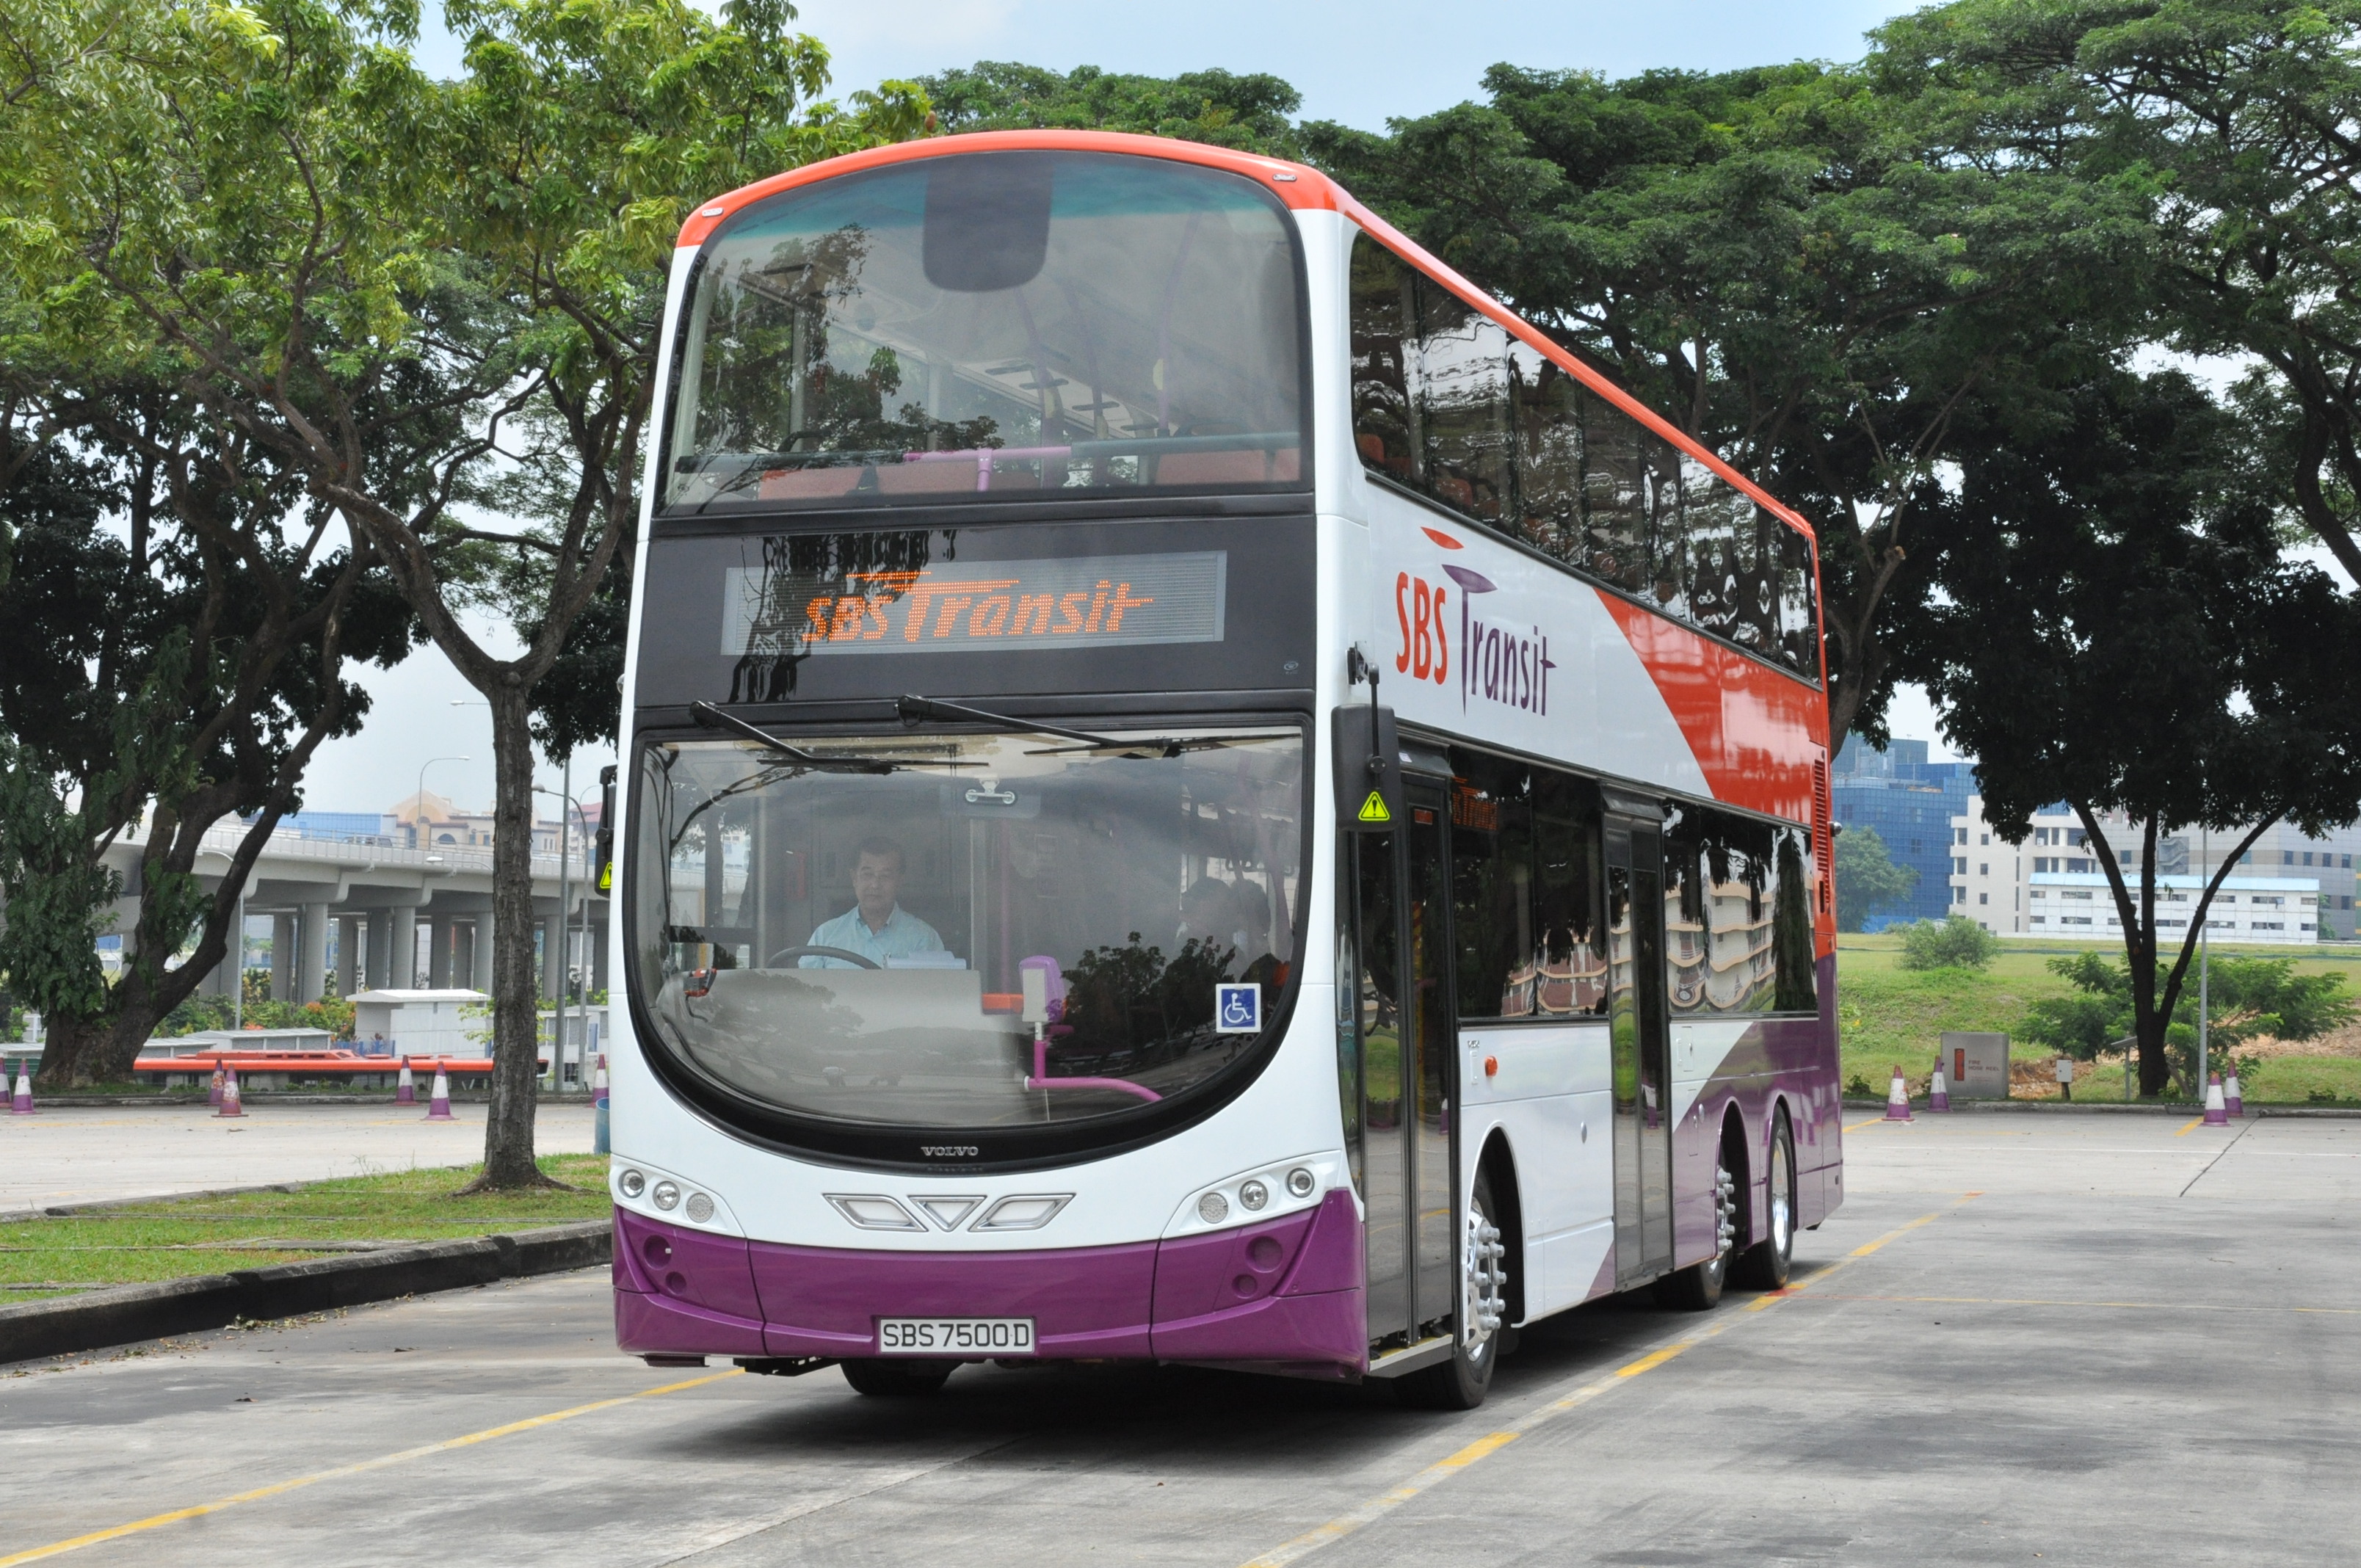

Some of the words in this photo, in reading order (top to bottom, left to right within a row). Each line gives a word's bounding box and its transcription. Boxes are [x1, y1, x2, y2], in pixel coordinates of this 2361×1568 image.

[802, 596, 893, 642] SBS
[882, 579, 1154, 642] Transit
[1396, 571, 1448, 685] SBS
[1442, 564, 1557, 717] Transit
[921, 1146, 979, 1156] VOLVO
